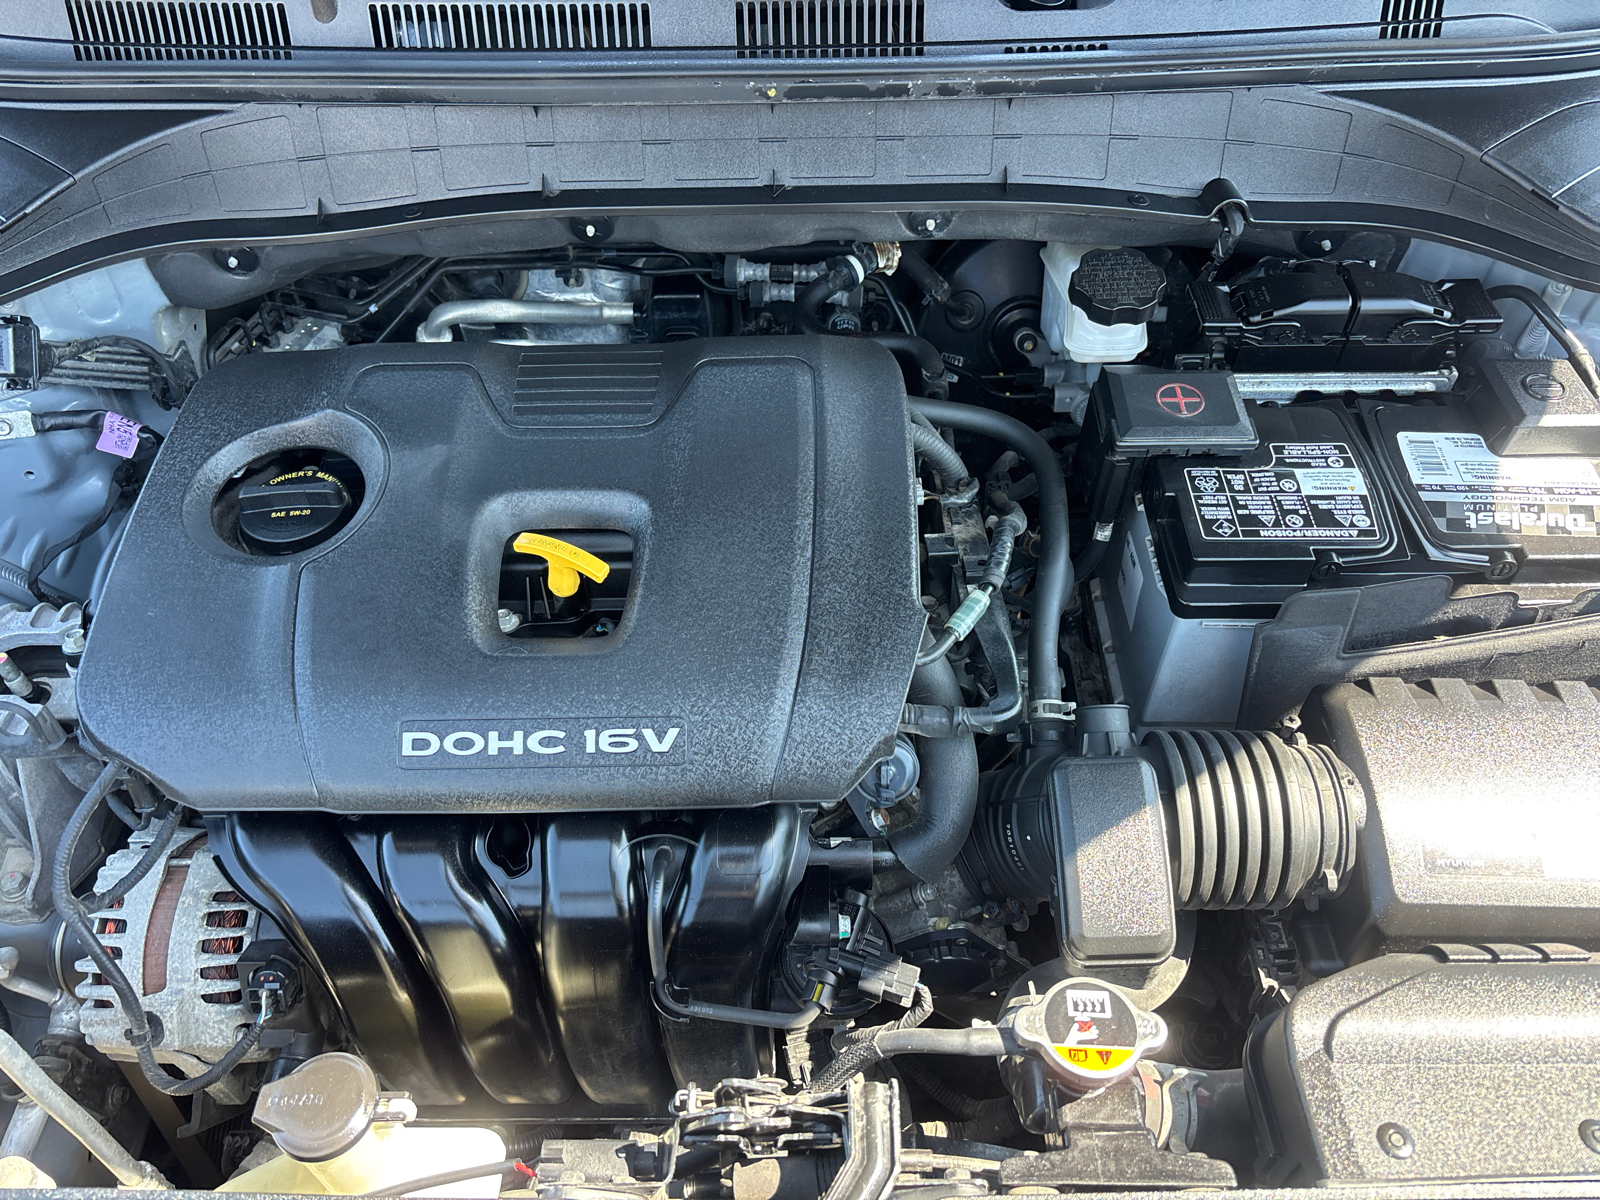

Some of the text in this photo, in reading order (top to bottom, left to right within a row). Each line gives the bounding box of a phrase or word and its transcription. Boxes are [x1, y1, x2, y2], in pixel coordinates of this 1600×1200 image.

[269, 470, 314, 485] OWNER'S
[289, 509, 311, 517] 5W-20
[1463, 504, 1538, 513] PLATINUM
[1464, 511, 1596, 532] Duralast
[534, 538, 583, 560] ENGINE OIL
[401, 727, 681, 757] DOHC 16V
